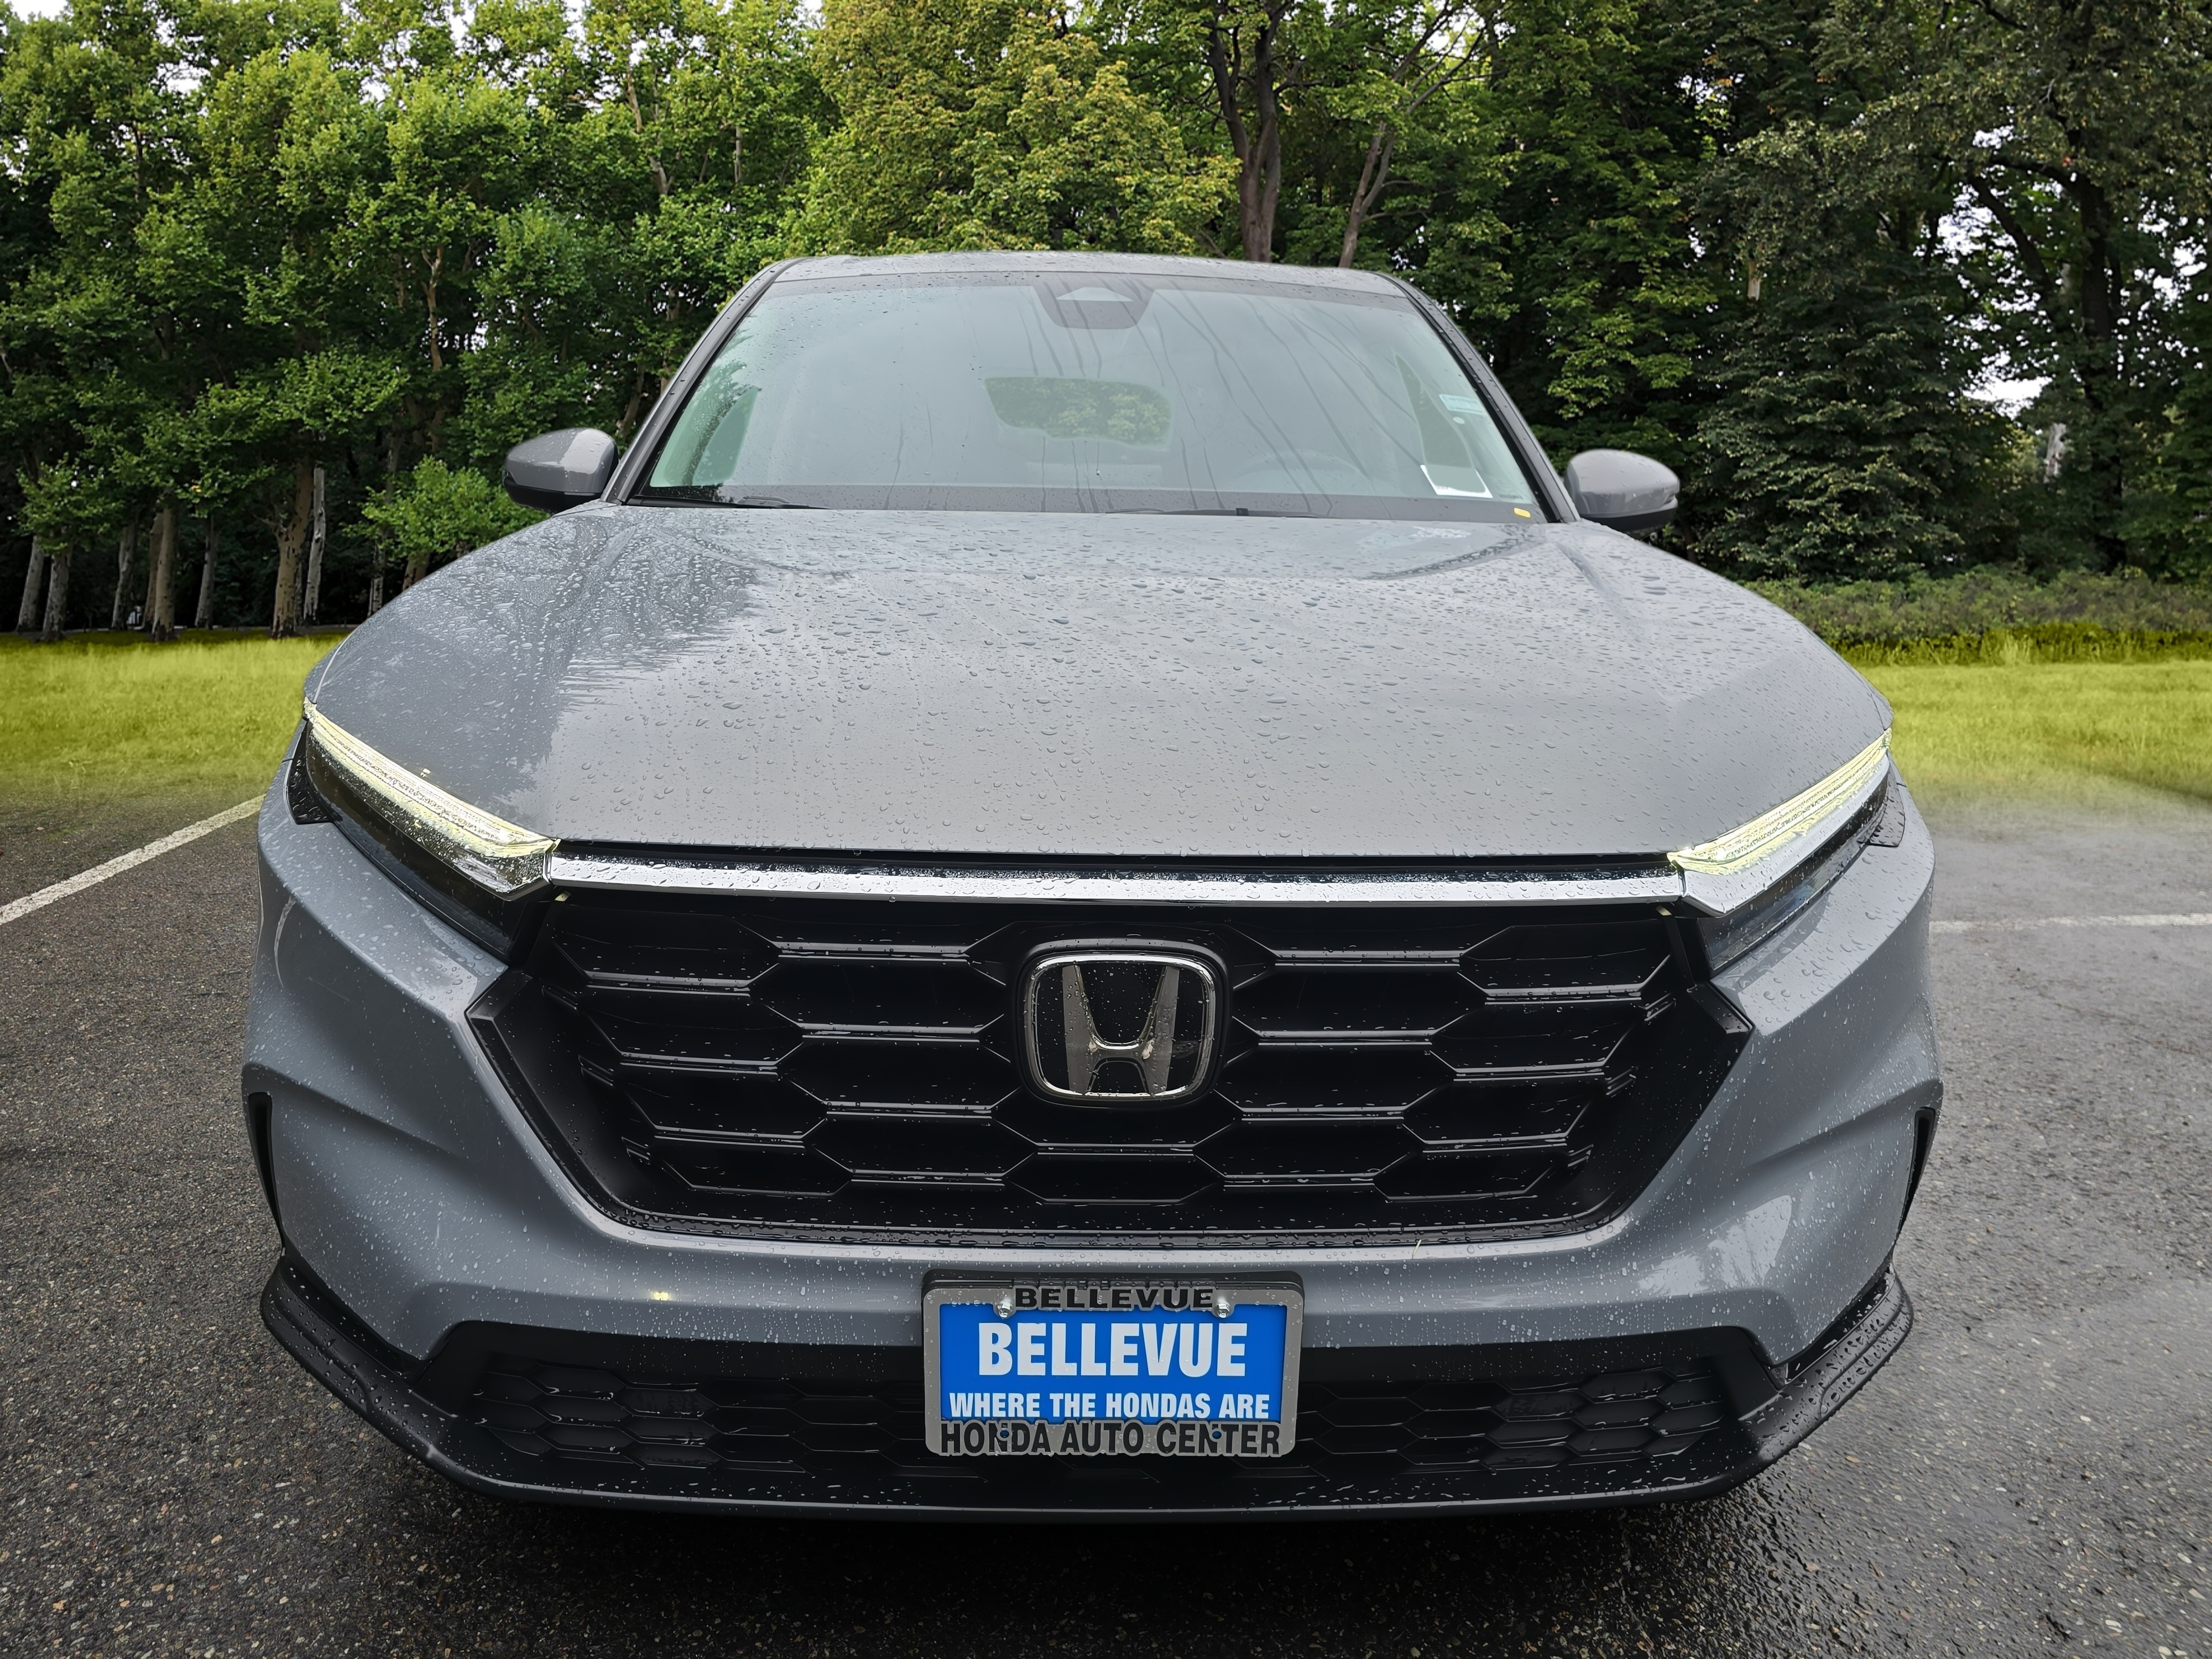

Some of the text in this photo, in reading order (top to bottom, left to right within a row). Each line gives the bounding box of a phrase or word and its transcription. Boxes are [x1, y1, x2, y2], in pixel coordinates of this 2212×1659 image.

[1014, 1287, 1214, 1310] BELLEVUE
[978, 1322, 1248, 1377] BELLEVUE
[949, 1392, 1270, 1420] WHERE THE HONDAS ARE
[941, 1421, 1281, 1455] HONDA AUTO CENTER
